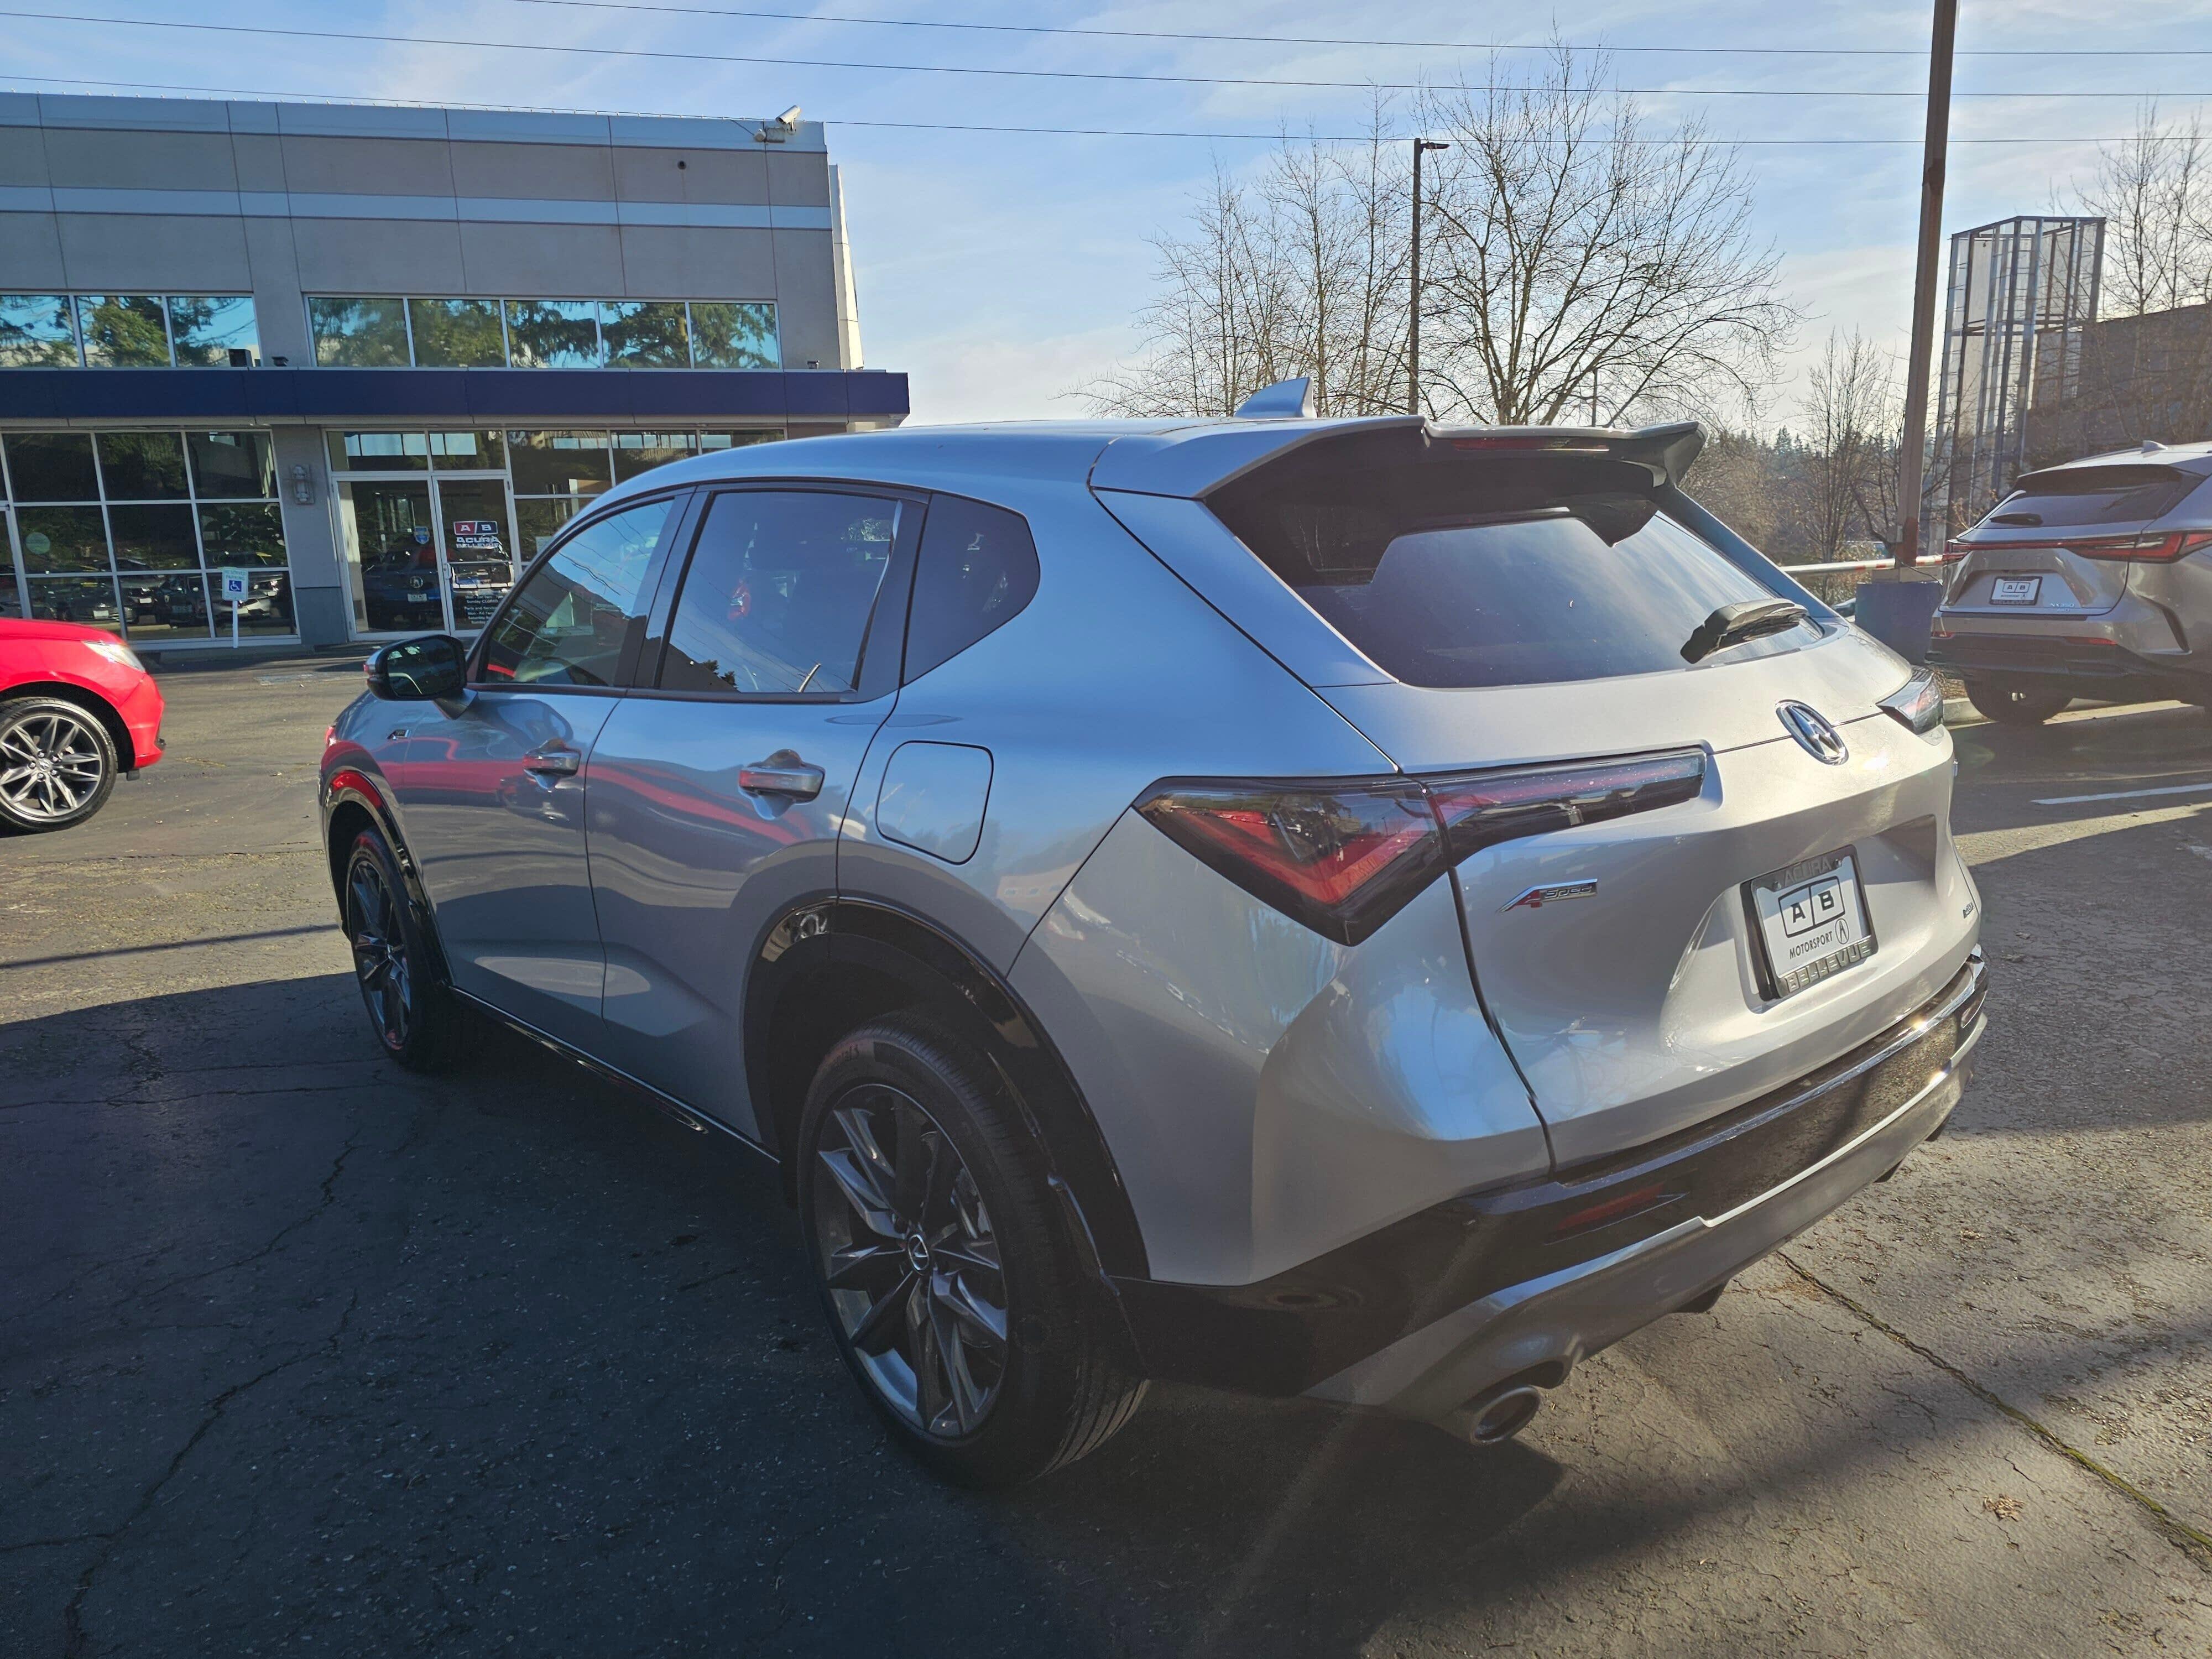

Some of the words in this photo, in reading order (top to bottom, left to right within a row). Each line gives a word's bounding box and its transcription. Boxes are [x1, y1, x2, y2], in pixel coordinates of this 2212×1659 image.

[1783, 859, 1833, 886] ACURA
[1790, 902, 1806, 924] A
[1818, 890, 1834, 911] B
[1789, 931, 1833, 959] MOTORSPORT
[1785, 938, 1871, 993] BELLEVUE
